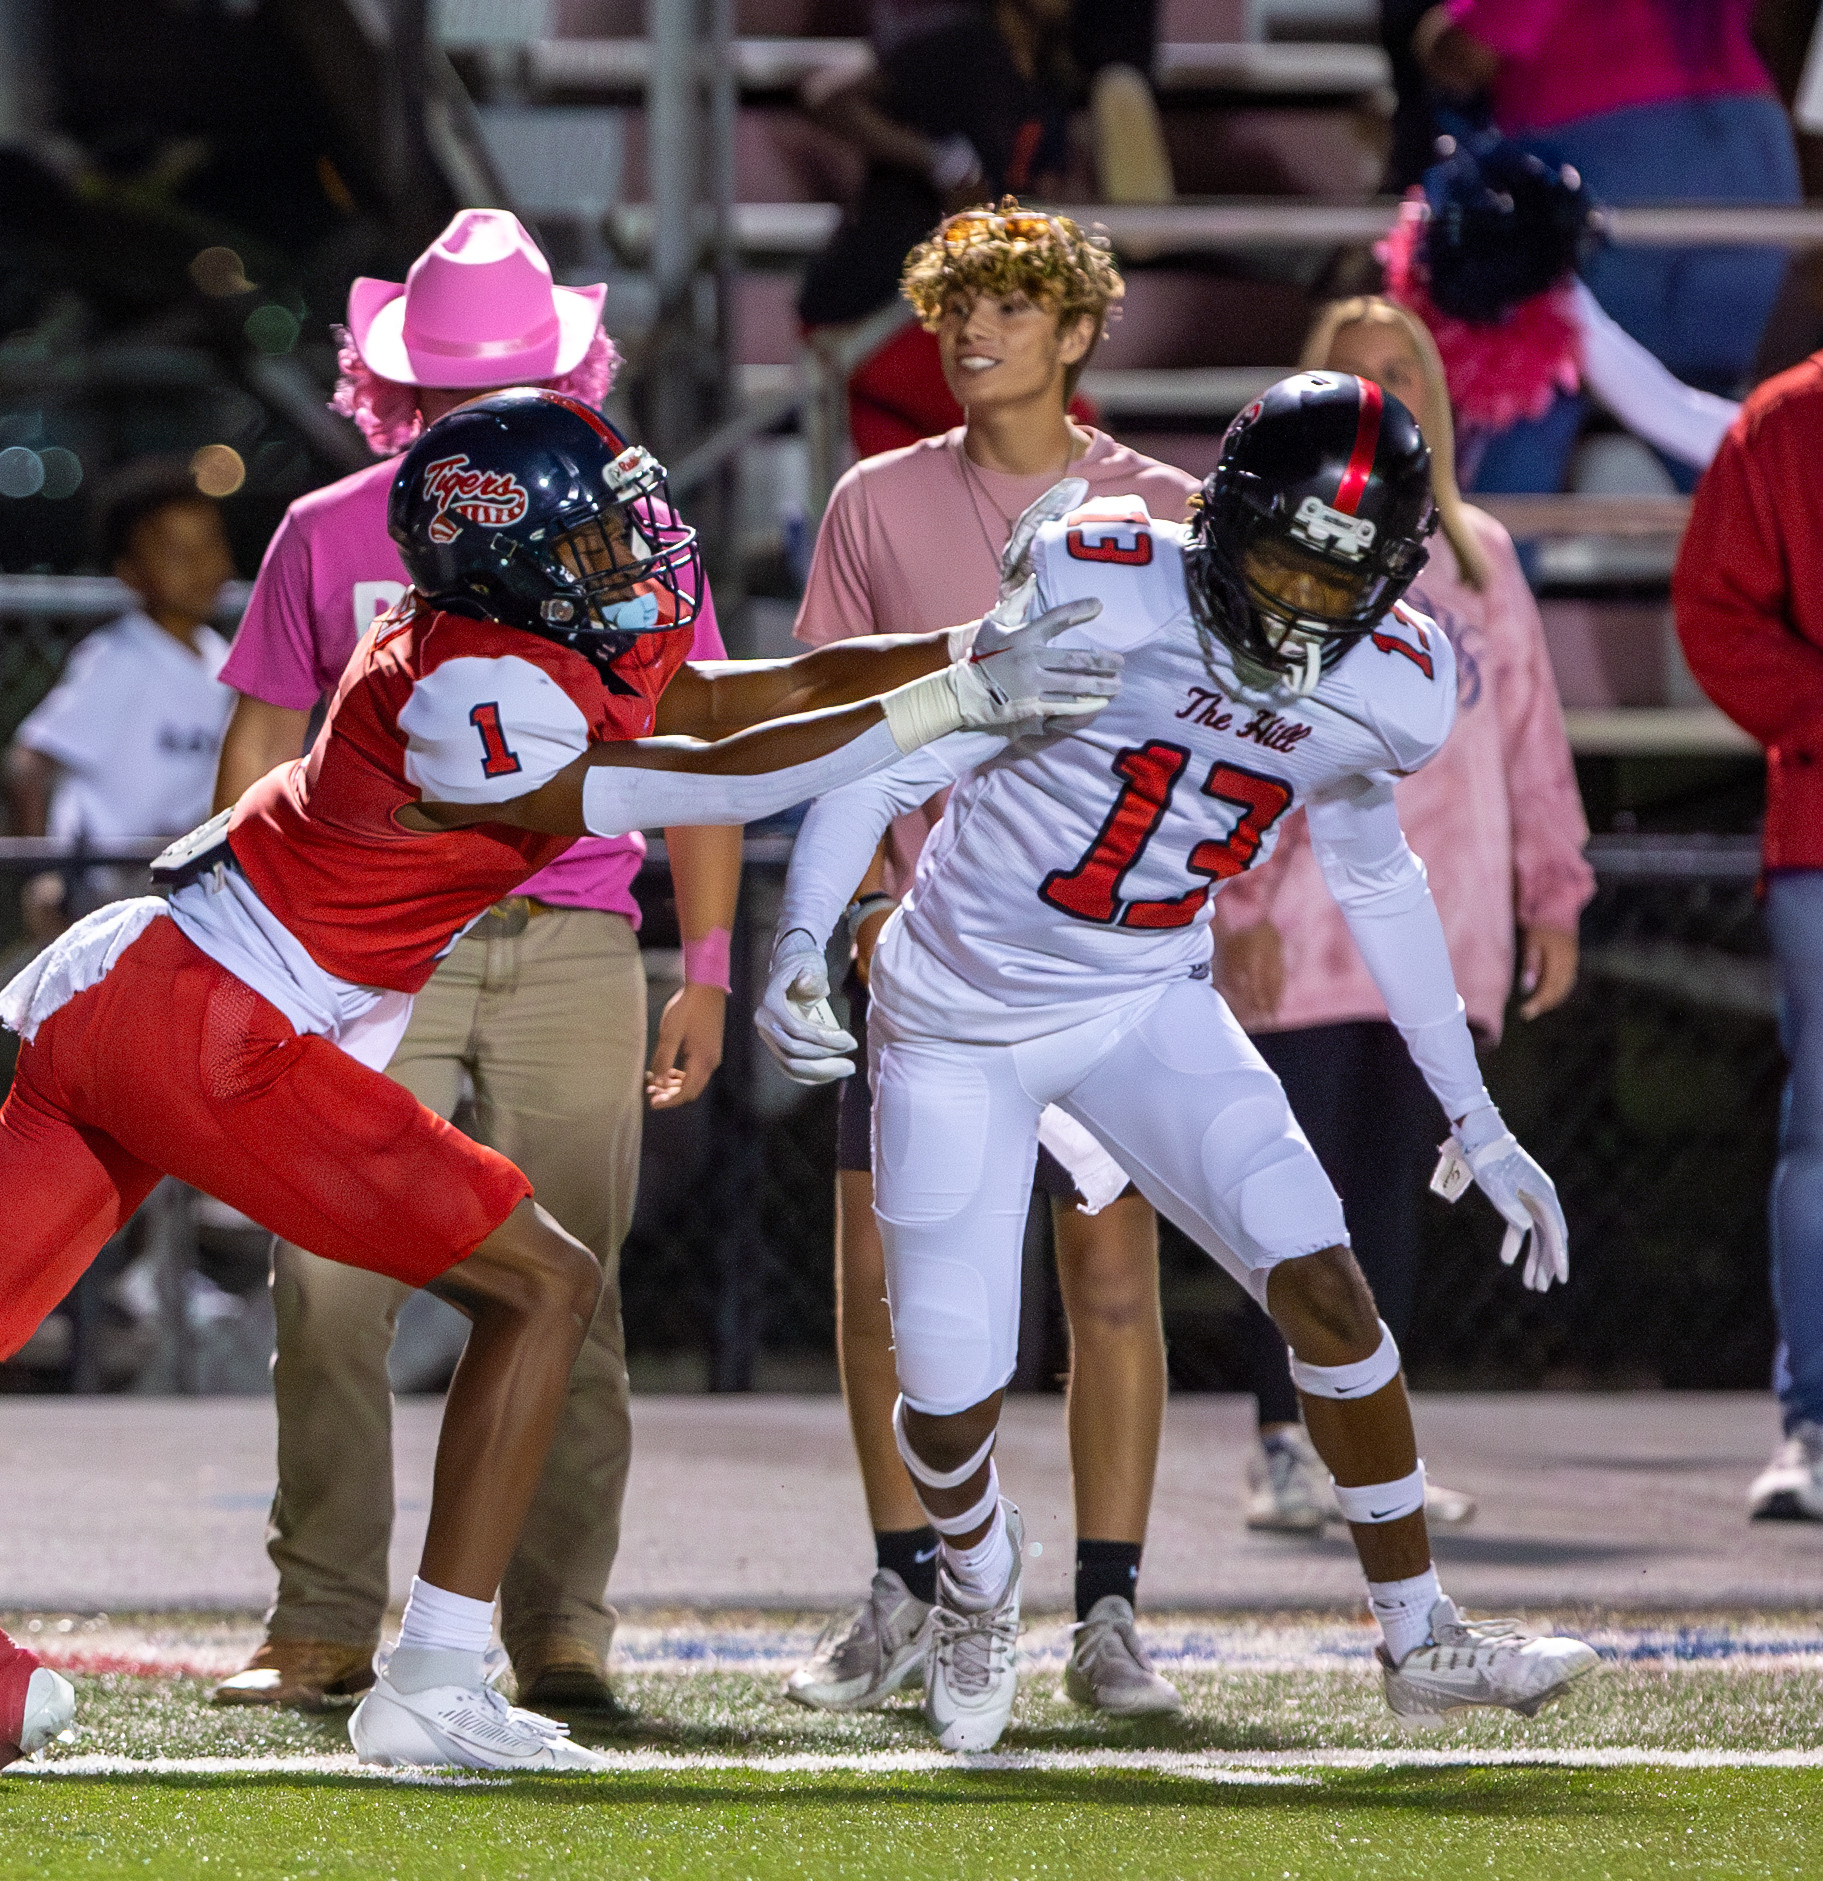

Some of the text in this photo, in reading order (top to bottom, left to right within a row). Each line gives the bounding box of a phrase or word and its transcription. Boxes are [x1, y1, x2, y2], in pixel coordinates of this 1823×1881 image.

[423, 453, 522, 515] Tigers
[469, 701, 522, 779] 1
[1175, 686, 1313, 753] The Hill
[1037, 739, 1294, 929] 13
